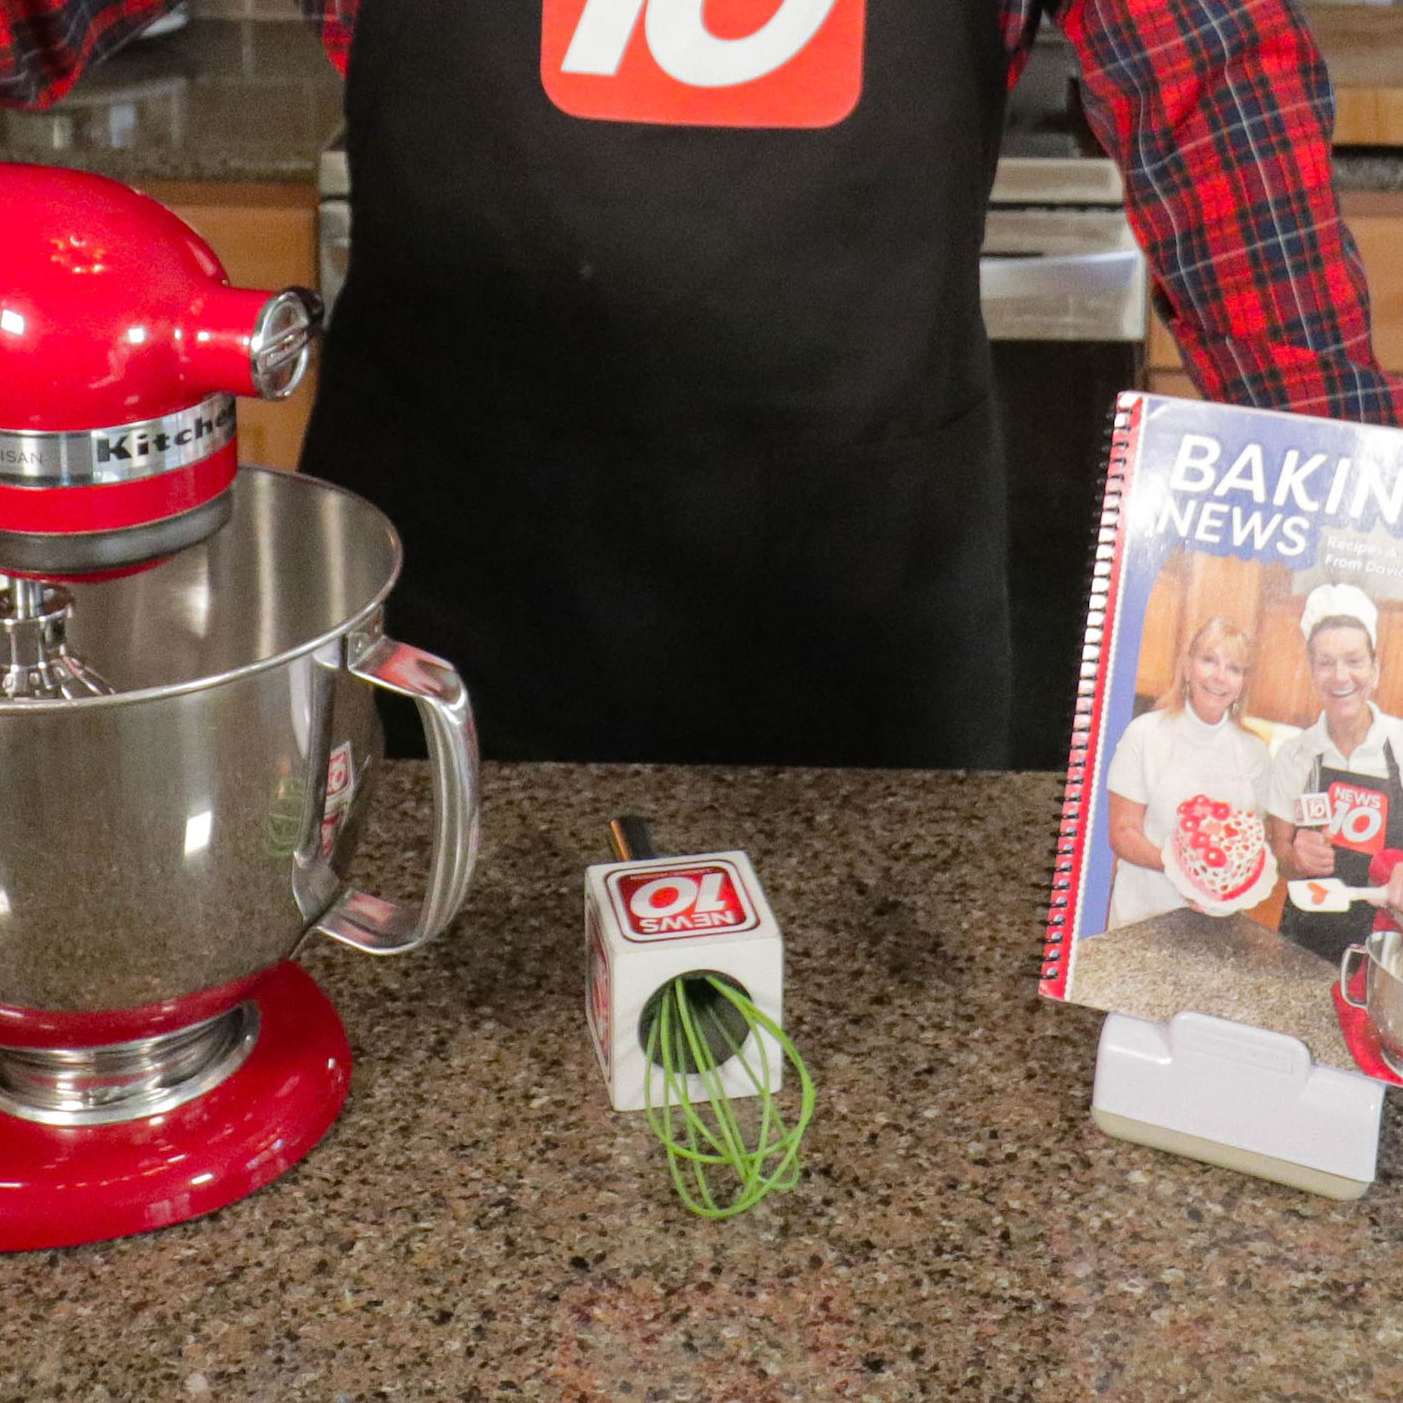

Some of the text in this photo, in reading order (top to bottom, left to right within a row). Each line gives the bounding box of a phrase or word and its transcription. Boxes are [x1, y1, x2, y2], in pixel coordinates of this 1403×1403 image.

[1155, 496, 1311, 557] NEWS
[1327, 535, 1382, 556] Recipes
[1324, 553, 1363, 571] From
[1334, 786, 1381, 809] NEWS
[1328, 800, 1383, 844] 10
[630, 872, 726, 918] 10
[640, 910, 736, 933] NEWS
